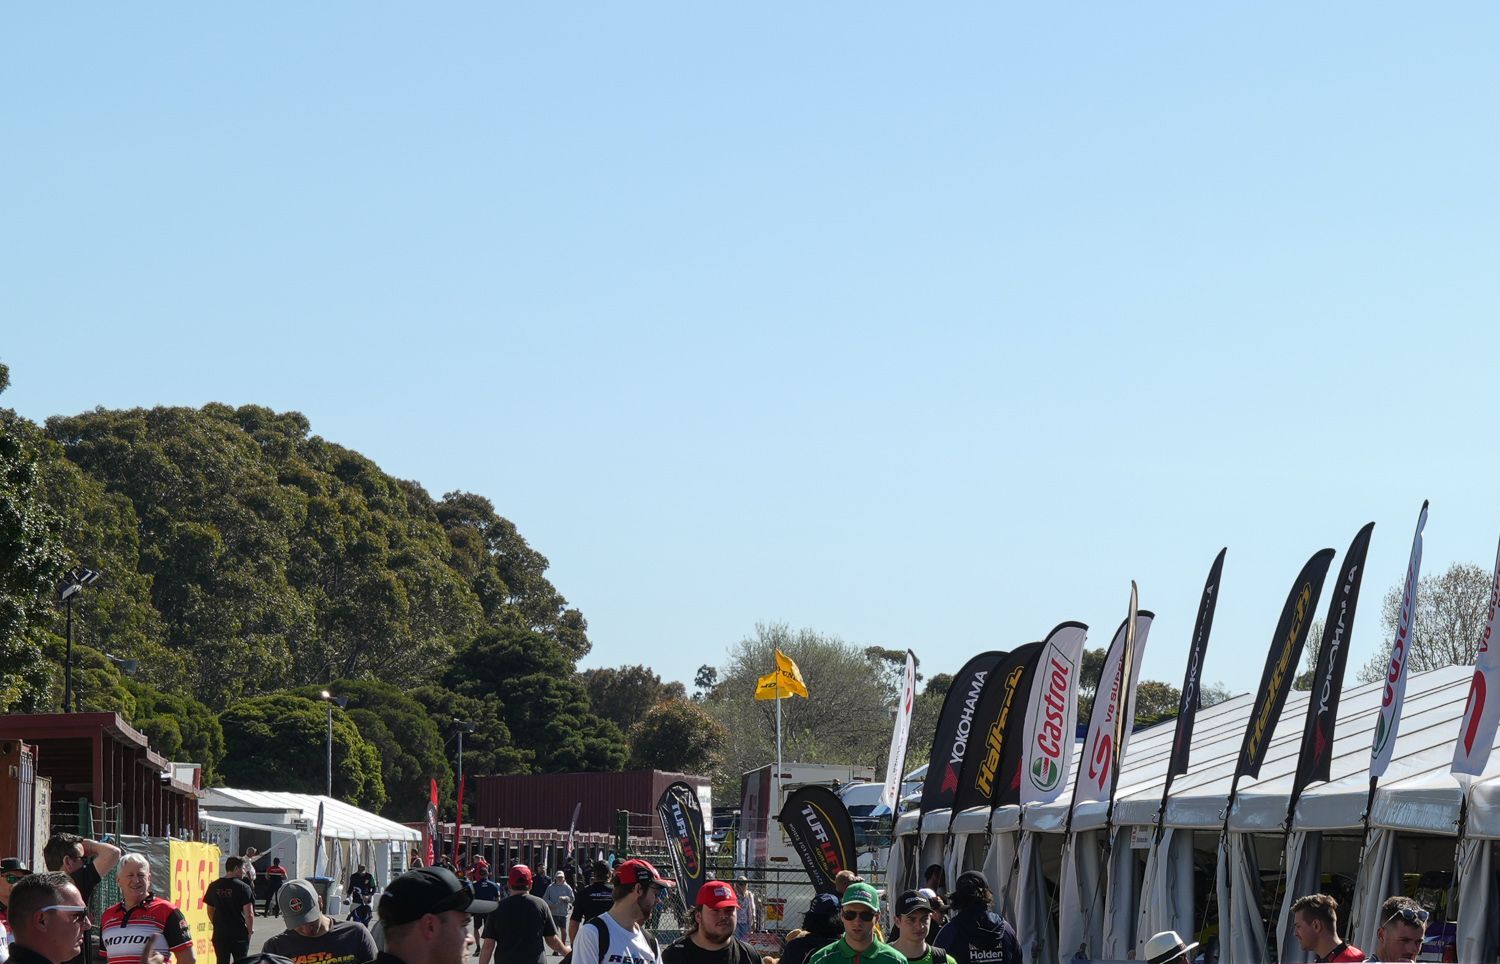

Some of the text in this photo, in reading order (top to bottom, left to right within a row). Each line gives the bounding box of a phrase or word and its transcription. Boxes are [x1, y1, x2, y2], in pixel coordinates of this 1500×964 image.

[949, 670, 989, 764] YOKOHAMA
[1037, 657, 1070, 759] Castrol
[969, 950, 1004, 960] Holden
